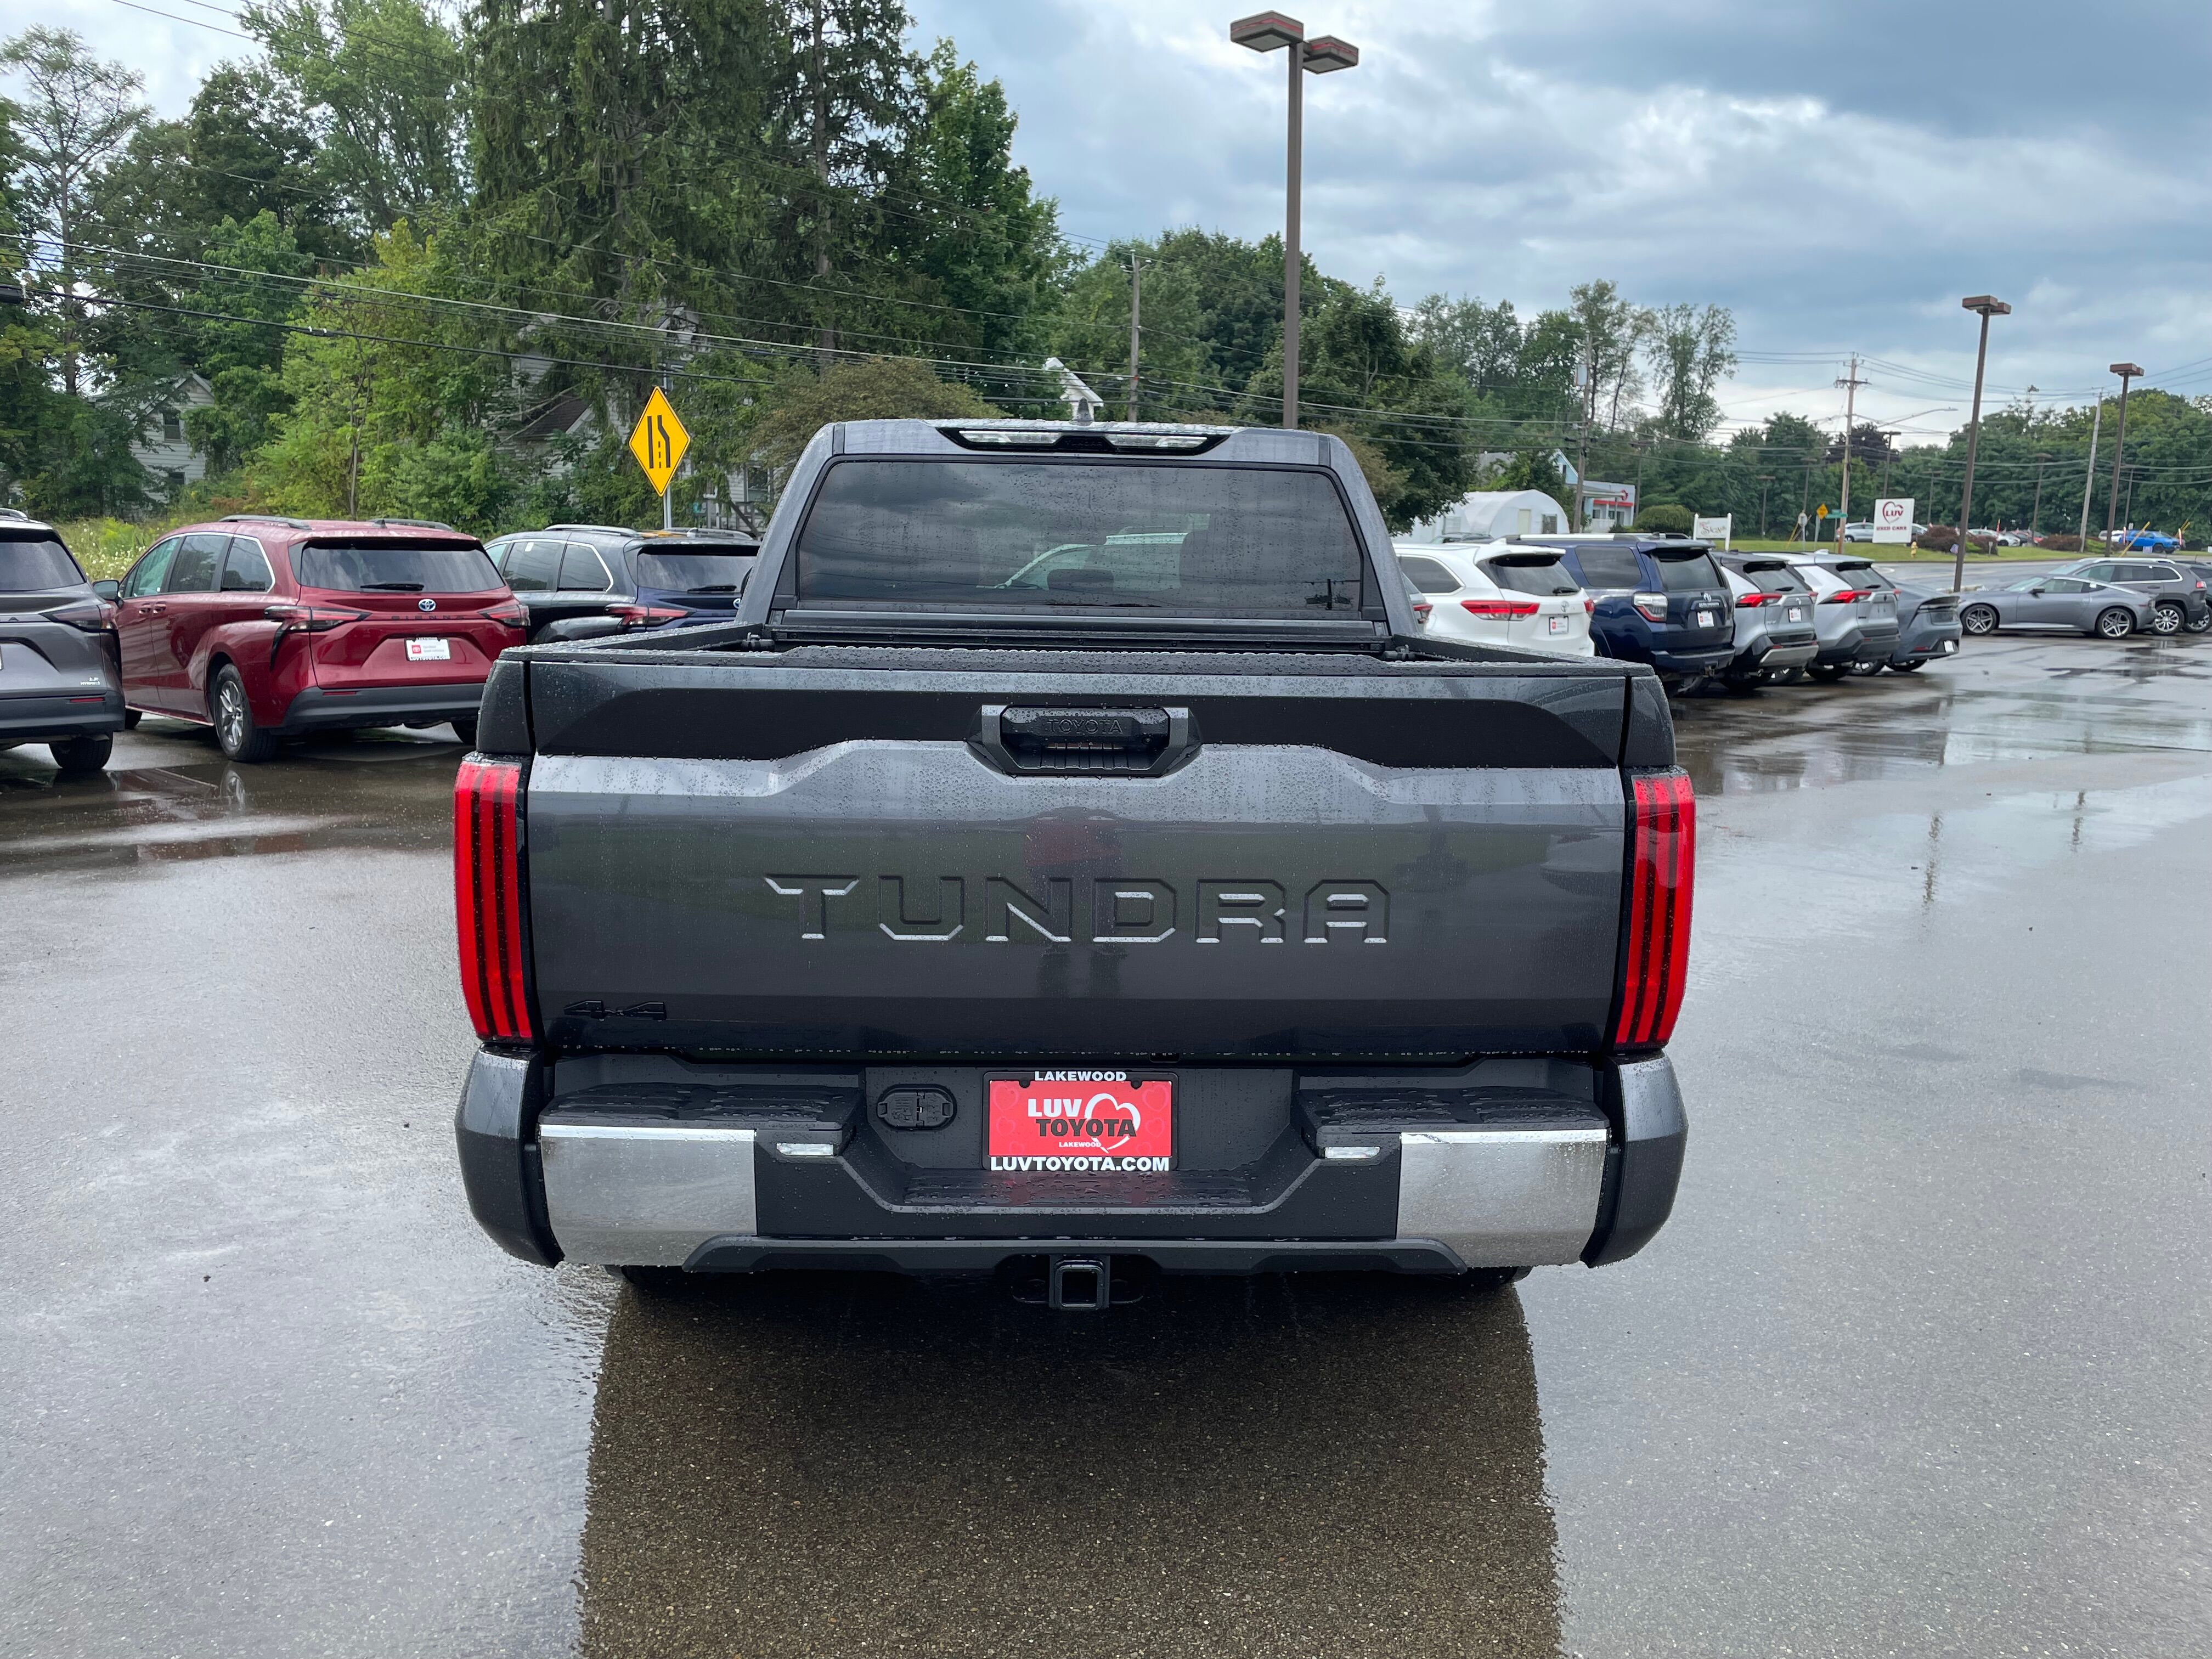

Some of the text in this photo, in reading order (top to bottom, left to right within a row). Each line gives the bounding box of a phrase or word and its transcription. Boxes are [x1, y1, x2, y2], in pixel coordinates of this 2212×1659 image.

[1047, 719, 1123, 735] TOYOTA
[764, 873, 1391, 944] TUNDRA
[1035, 1071, 1127, 1082] LAKEWOOD
[1028, 1098, 1082, 1118] LUV
[1035, 1118, 1137, 1137] TOYOTA
[990, 1156, 1170, 1172] LUVTOYOTA.COM
